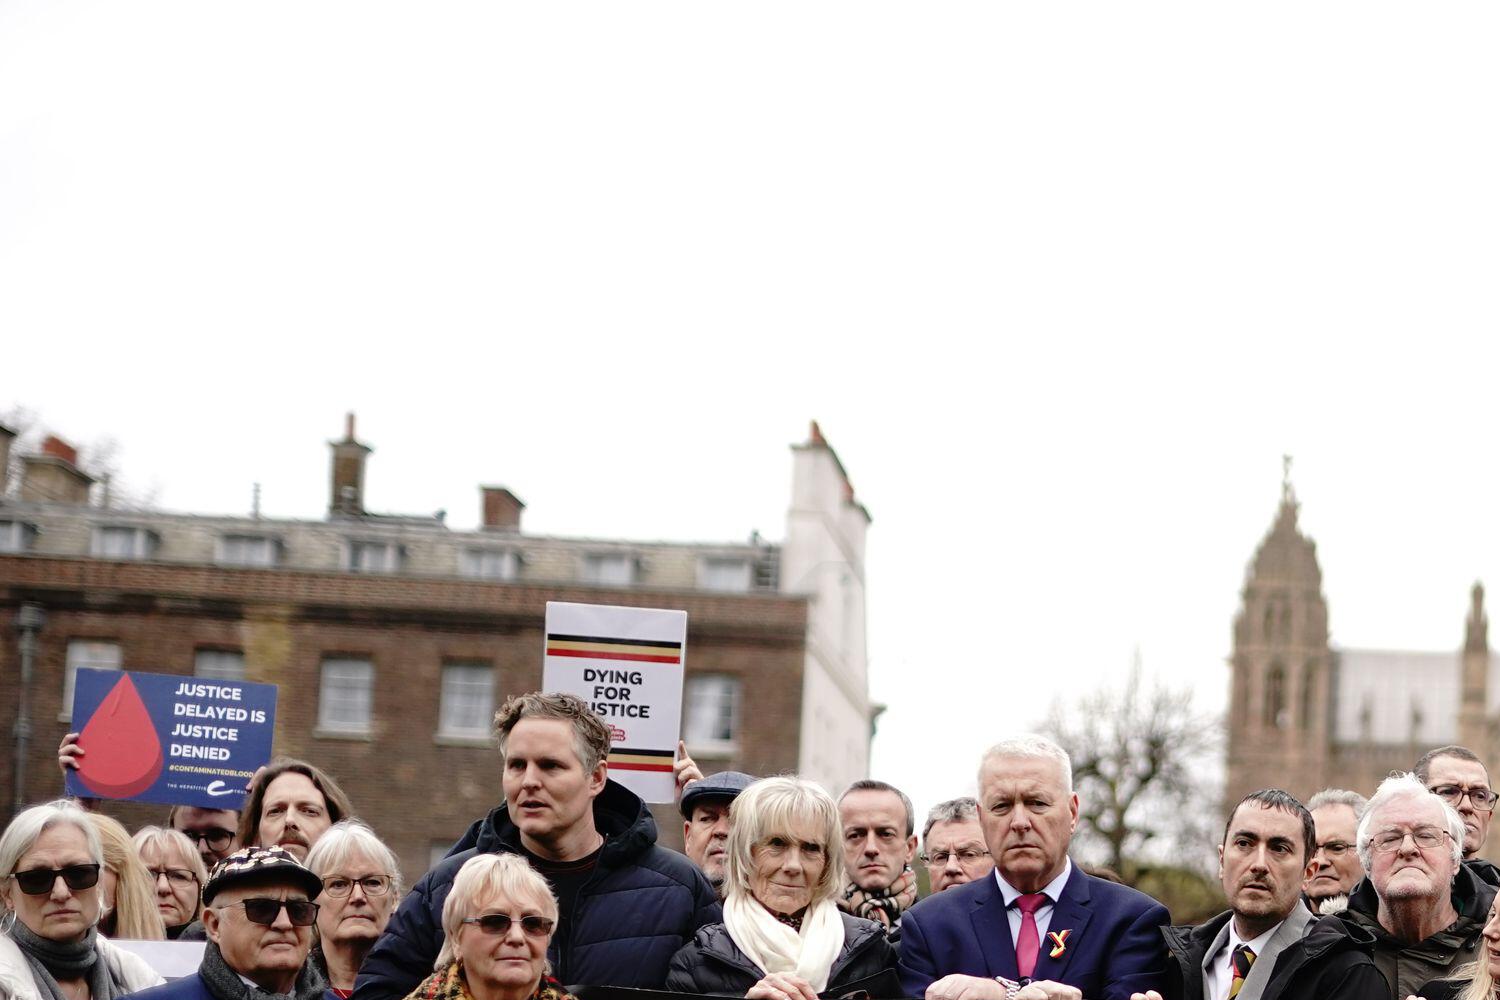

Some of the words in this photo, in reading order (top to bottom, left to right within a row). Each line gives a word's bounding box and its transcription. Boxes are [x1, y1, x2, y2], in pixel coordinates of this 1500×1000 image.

[583, 668, 643, 685] DYING
[175, 682, 242, 700] JUSTICE
[593, 686, 631, 701] FOR
[174, 703, 247, 722] DELAYED
[250, 710, 266, 723] IS
[585, 701, 650, 718] STICE
[171, 723, 238, 741] JUSTICE
[170, 744, 230, 761] DENIED
[169, 764, 254, 778] #CONTAMINATEDBLOOD
